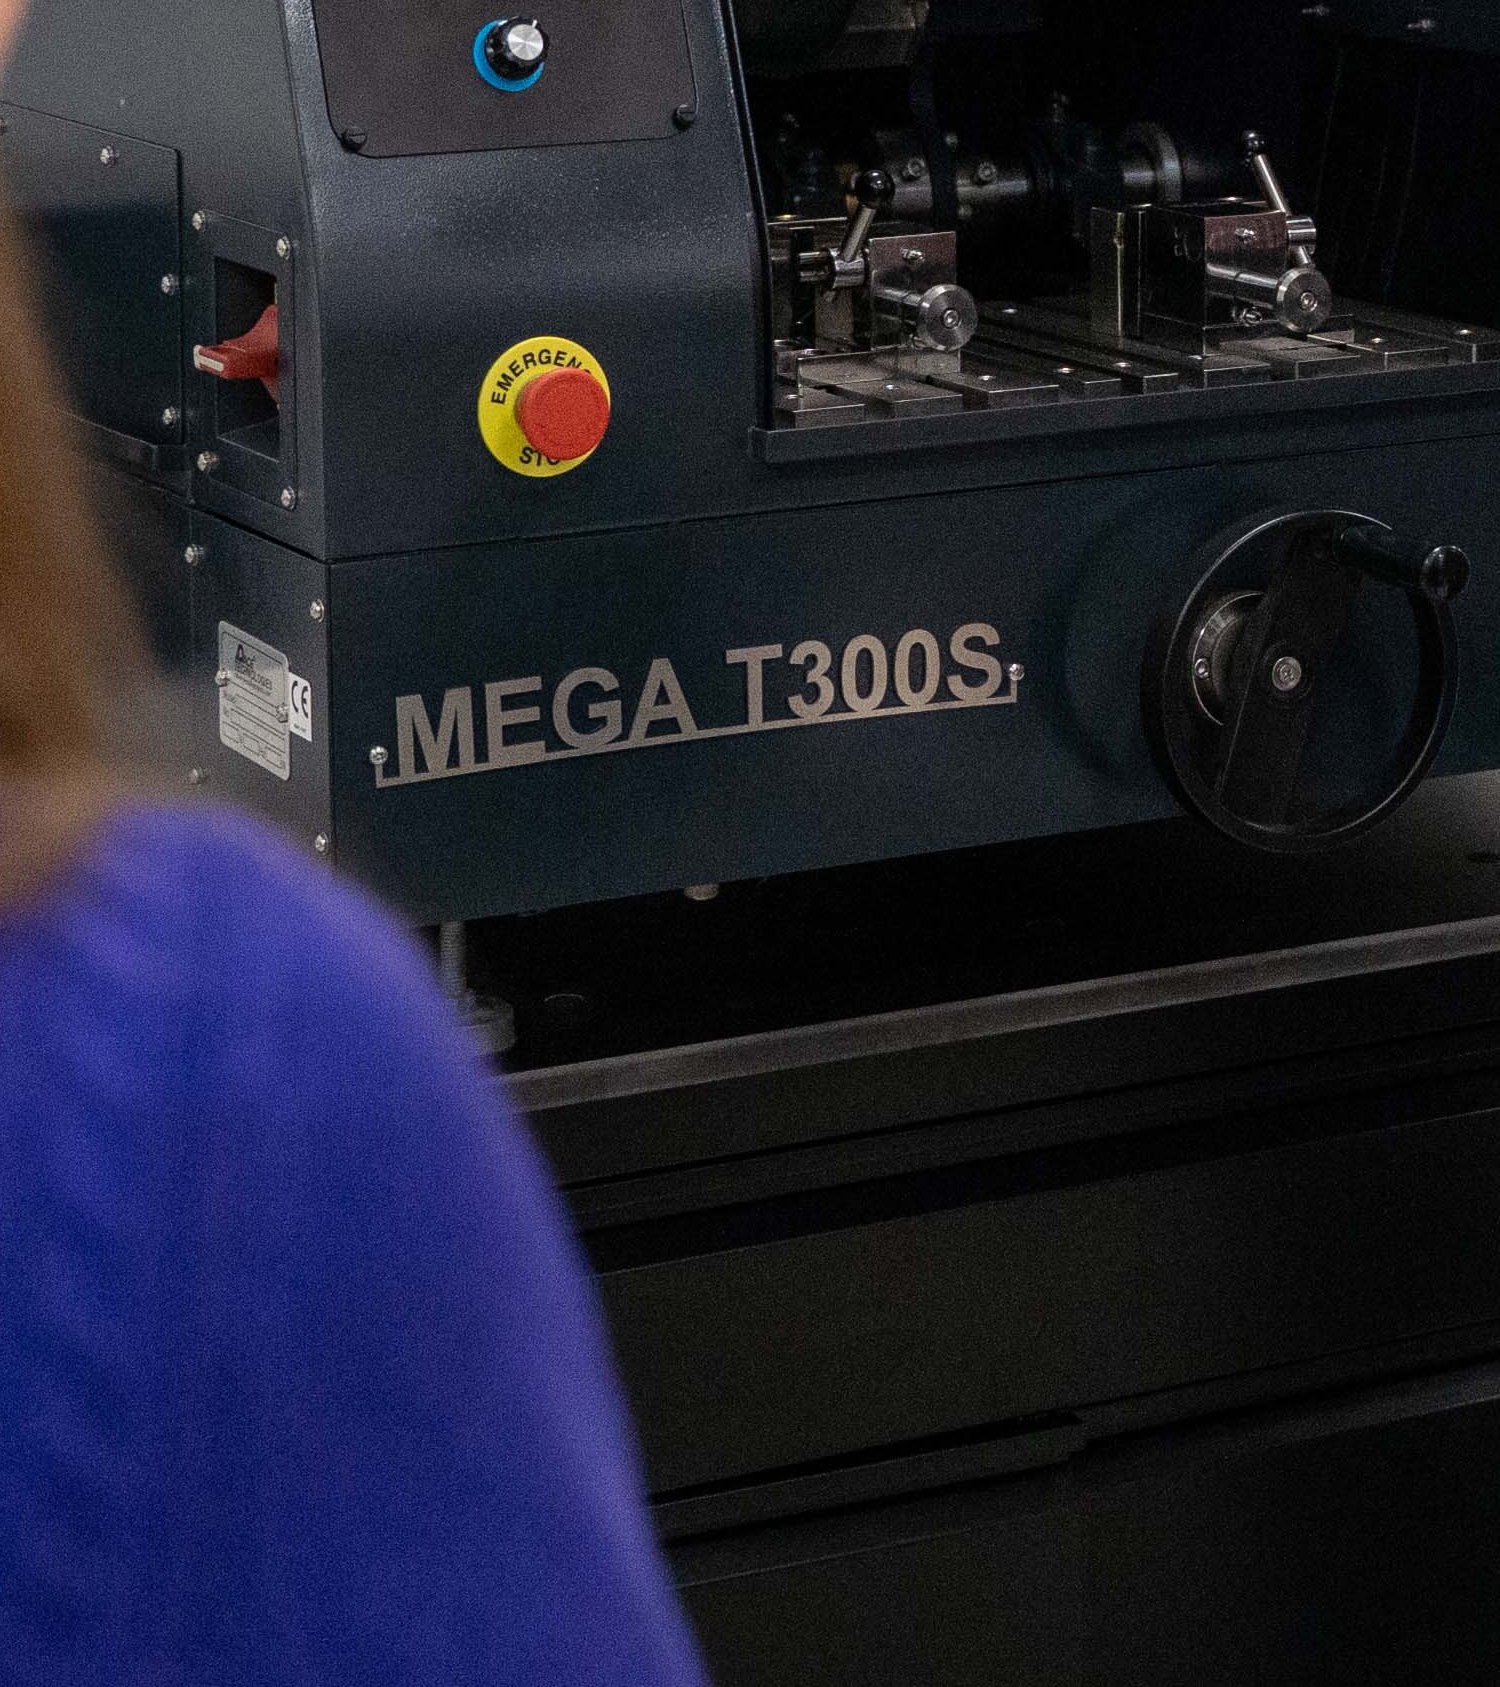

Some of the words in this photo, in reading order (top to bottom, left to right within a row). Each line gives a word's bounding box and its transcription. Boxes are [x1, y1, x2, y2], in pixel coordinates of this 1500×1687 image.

[490, 349, 591, 405] EMERGEN
[395, 657, 700, 777] MEGA
[726, 622, 1003, 729] T300S
